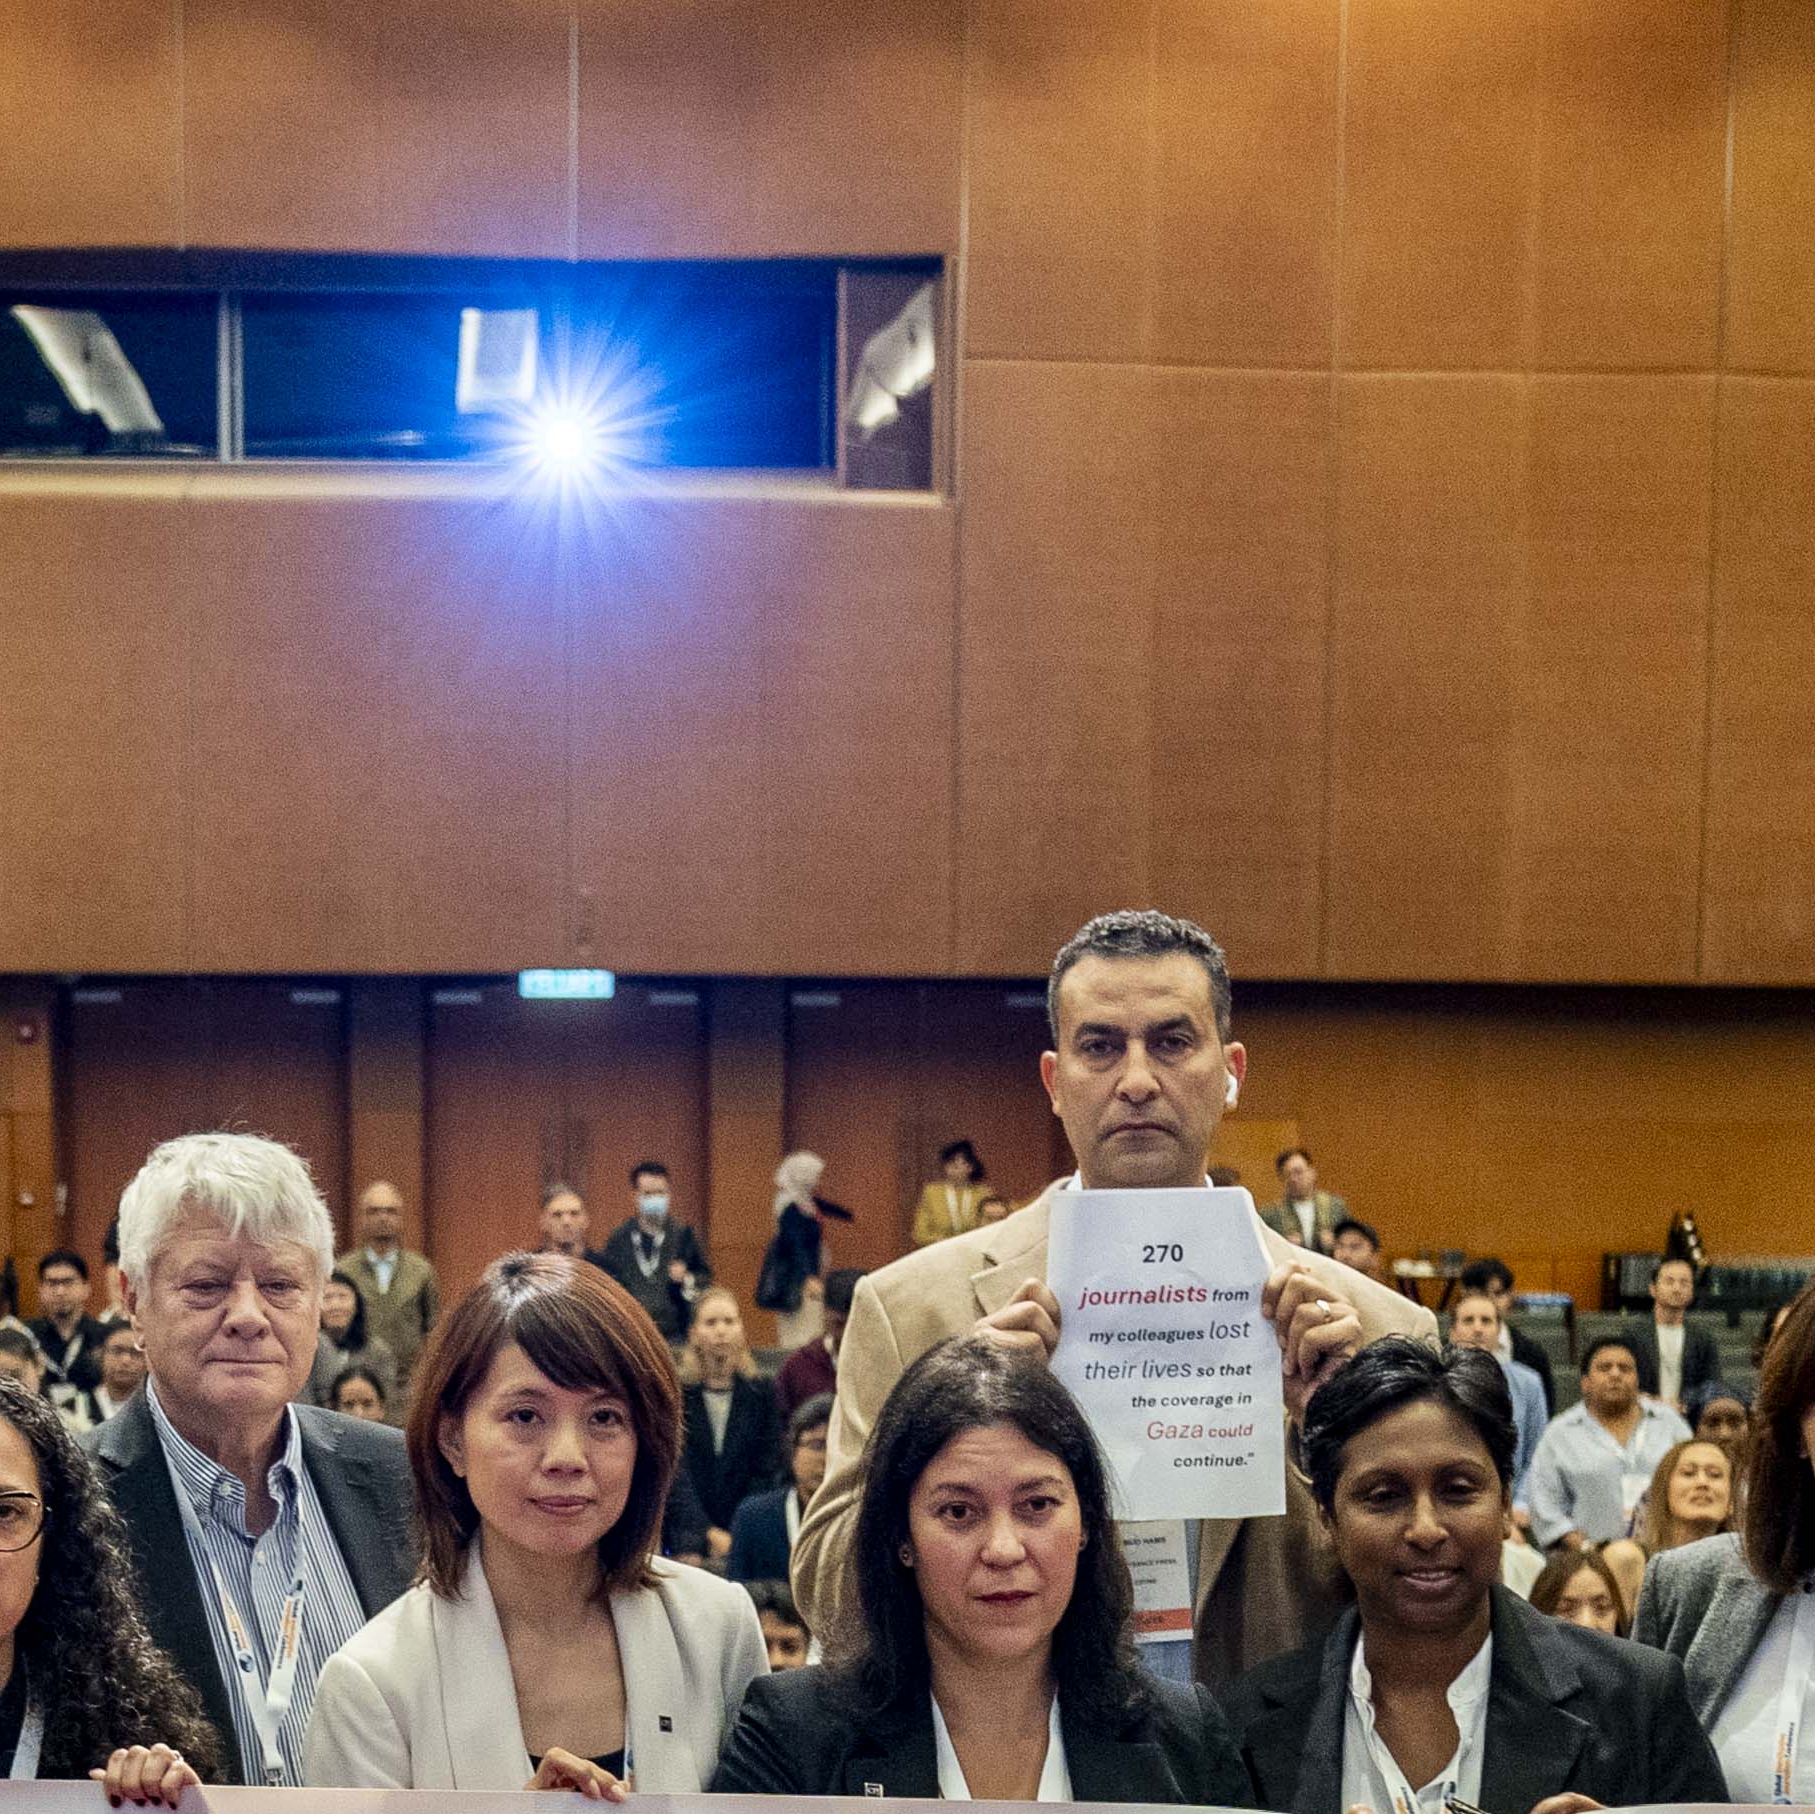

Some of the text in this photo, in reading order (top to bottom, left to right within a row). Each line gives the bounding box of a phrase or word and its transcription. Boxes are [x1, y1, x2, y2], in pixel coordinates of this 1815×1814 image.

[1142, 1243, 1184, 1264] 270
[1078, 1285, 1250, 1310] journalists from
[1088, 1319, 1252, 1345] my colleagues lost
[1085, 1358, 1253, 1380] their lives so that
[1131, 1391, 1253, 1409] the coverage in
[1146, 1420, 1255, 1440] Gaza could
